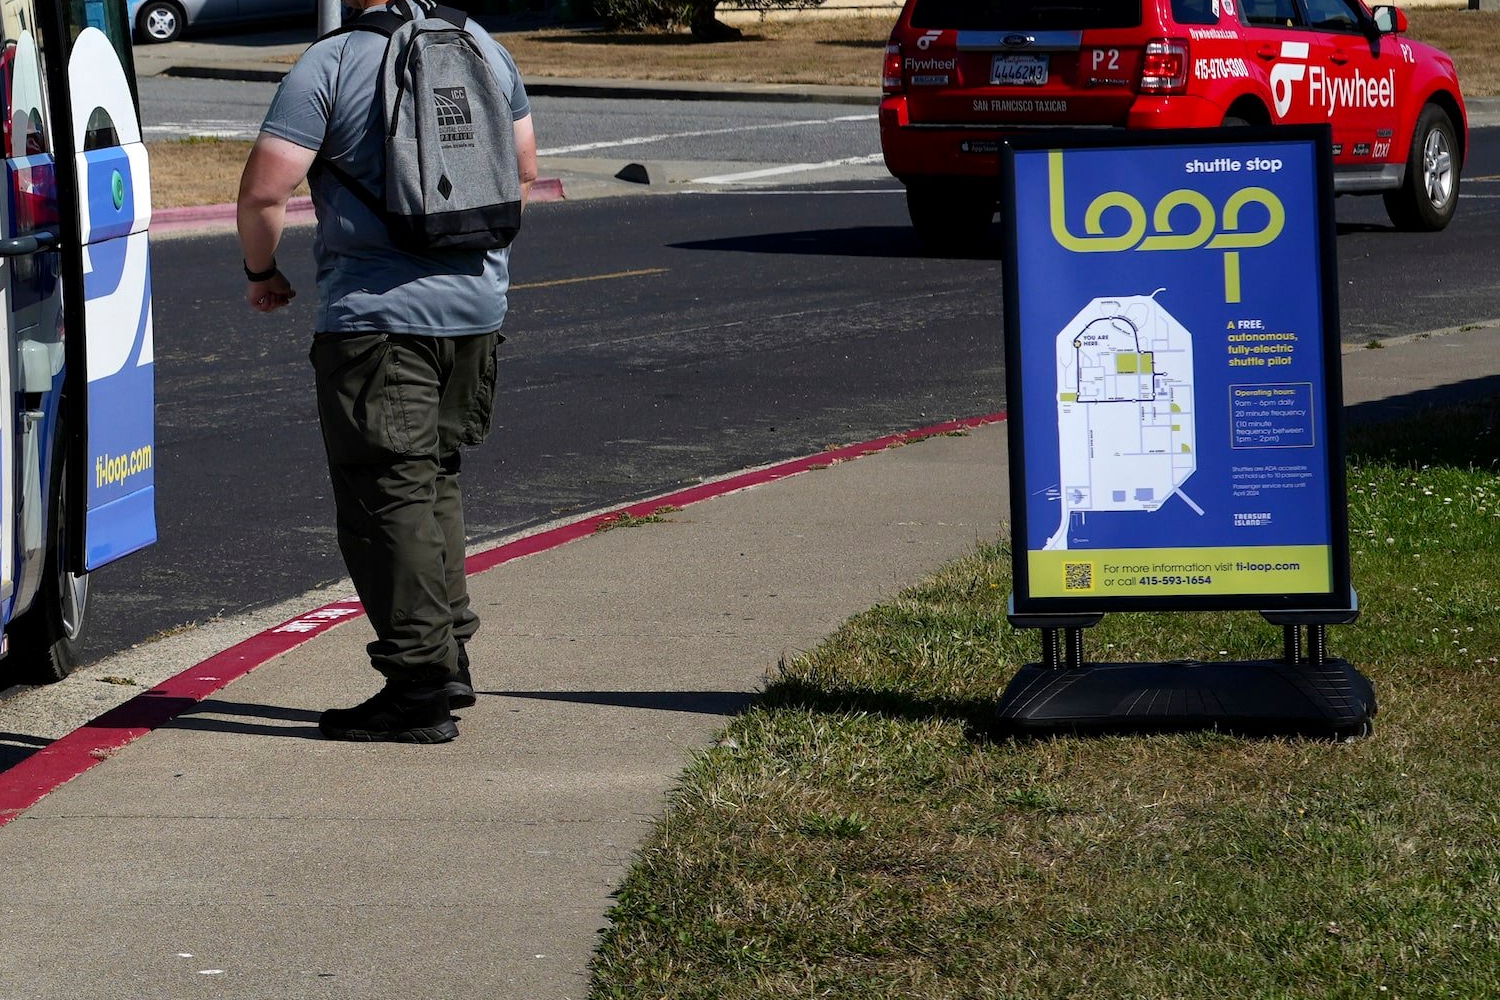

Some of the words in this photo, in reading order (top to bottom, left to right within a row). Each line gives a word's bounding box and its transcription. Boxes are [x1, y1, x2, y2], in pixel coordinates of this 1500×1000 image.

[1189, 28, 1239, 42] flywheeltaxi.com
[1400, 43, 1415, 64] P2
[904, 58, 955, 72] Flywheel
[1195, 57, 1249, 79] 415-970-1300
[995, 65, 1043, 80] 44462M3
[451, 90, 465, 99] ICC
[1309, 65, 1395, 117] Flywheel
[973, 100, 988, 111] SAN
[992, 100, 1033, 112] FRANCISCO
[1035, 100, 1067, 112] TAXICAB
[1372, 139, 1391, 159] taxi
[1185, 158, 1241, 173] shuttle
[1246, 157, 1283, 173] stop
[1048, 149, 1286, 303] loop
[1227, 321, 1235, 330] A
[1238, 320, 1265, 330] FREE,
[1228, 332, 1298, 342] autonomous,
[1228, 344, 1294, 355] fully-electric
[1228, 356, 1266, 367] shuttle
[1268, 355, 1292, 367] pilot
[1235, 389, 1272, 397] Operating
[1259, 400, 1276, 408] 6pm
[1278, 399, 1295, 407] daily
[1271, 409, 1306, 417] frequency
[1236, 428, 1271, 436] frequency
[96, 443, 152, 489] ti-loop.com
[1104, 564, 1119, 574] For
[1122, 565, 1150, 574] more
[1152, 562, 1212, 573] information
[1214, 562, 1234, 572] visit
[1236, 561, 1301, 574] ti-loop.com
[1104, 578, 1115, 586] or
[1117, 576, 1137, 586] call
[1139, 575, 1212, 586] 415-593-1654
